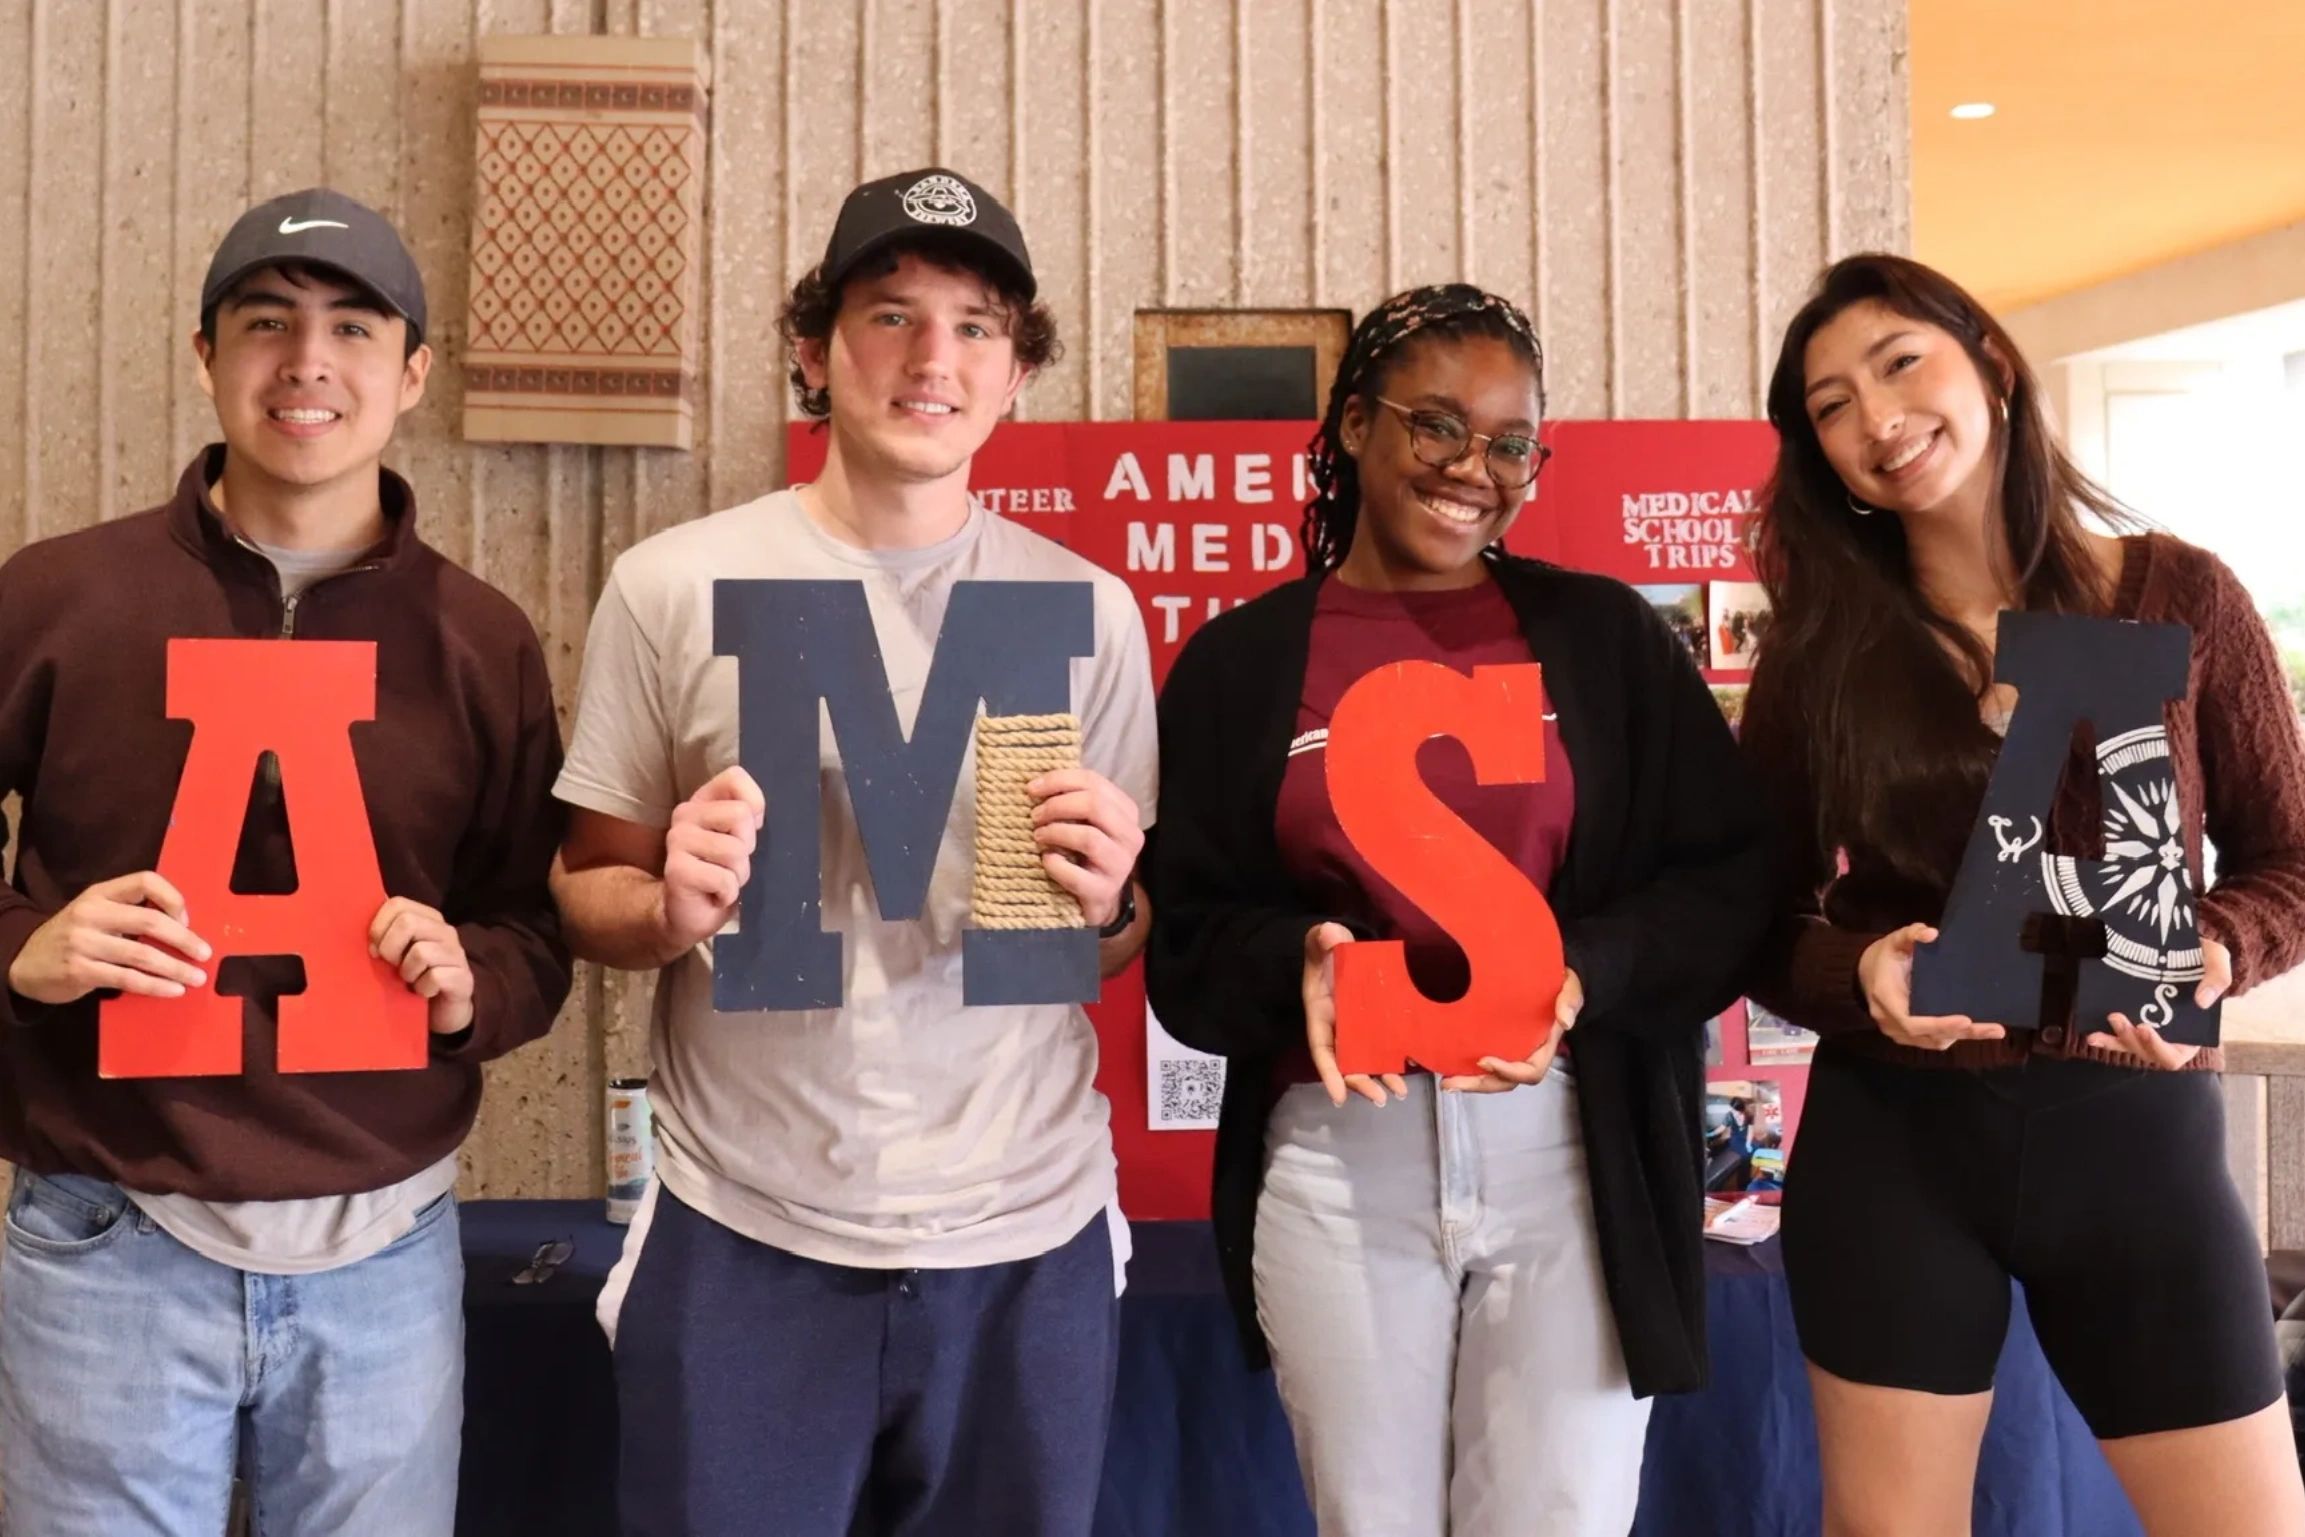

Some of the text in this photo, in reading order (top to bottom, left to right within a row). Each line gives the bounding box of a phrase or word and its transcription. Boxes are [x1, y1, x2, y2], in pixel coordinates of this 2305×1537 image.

[1622, 489, 1760, 518] MEDICAL
[1623, 517, 1741, 544] SCHOOL
[1643, 543, 1736, 569] TRIPS
